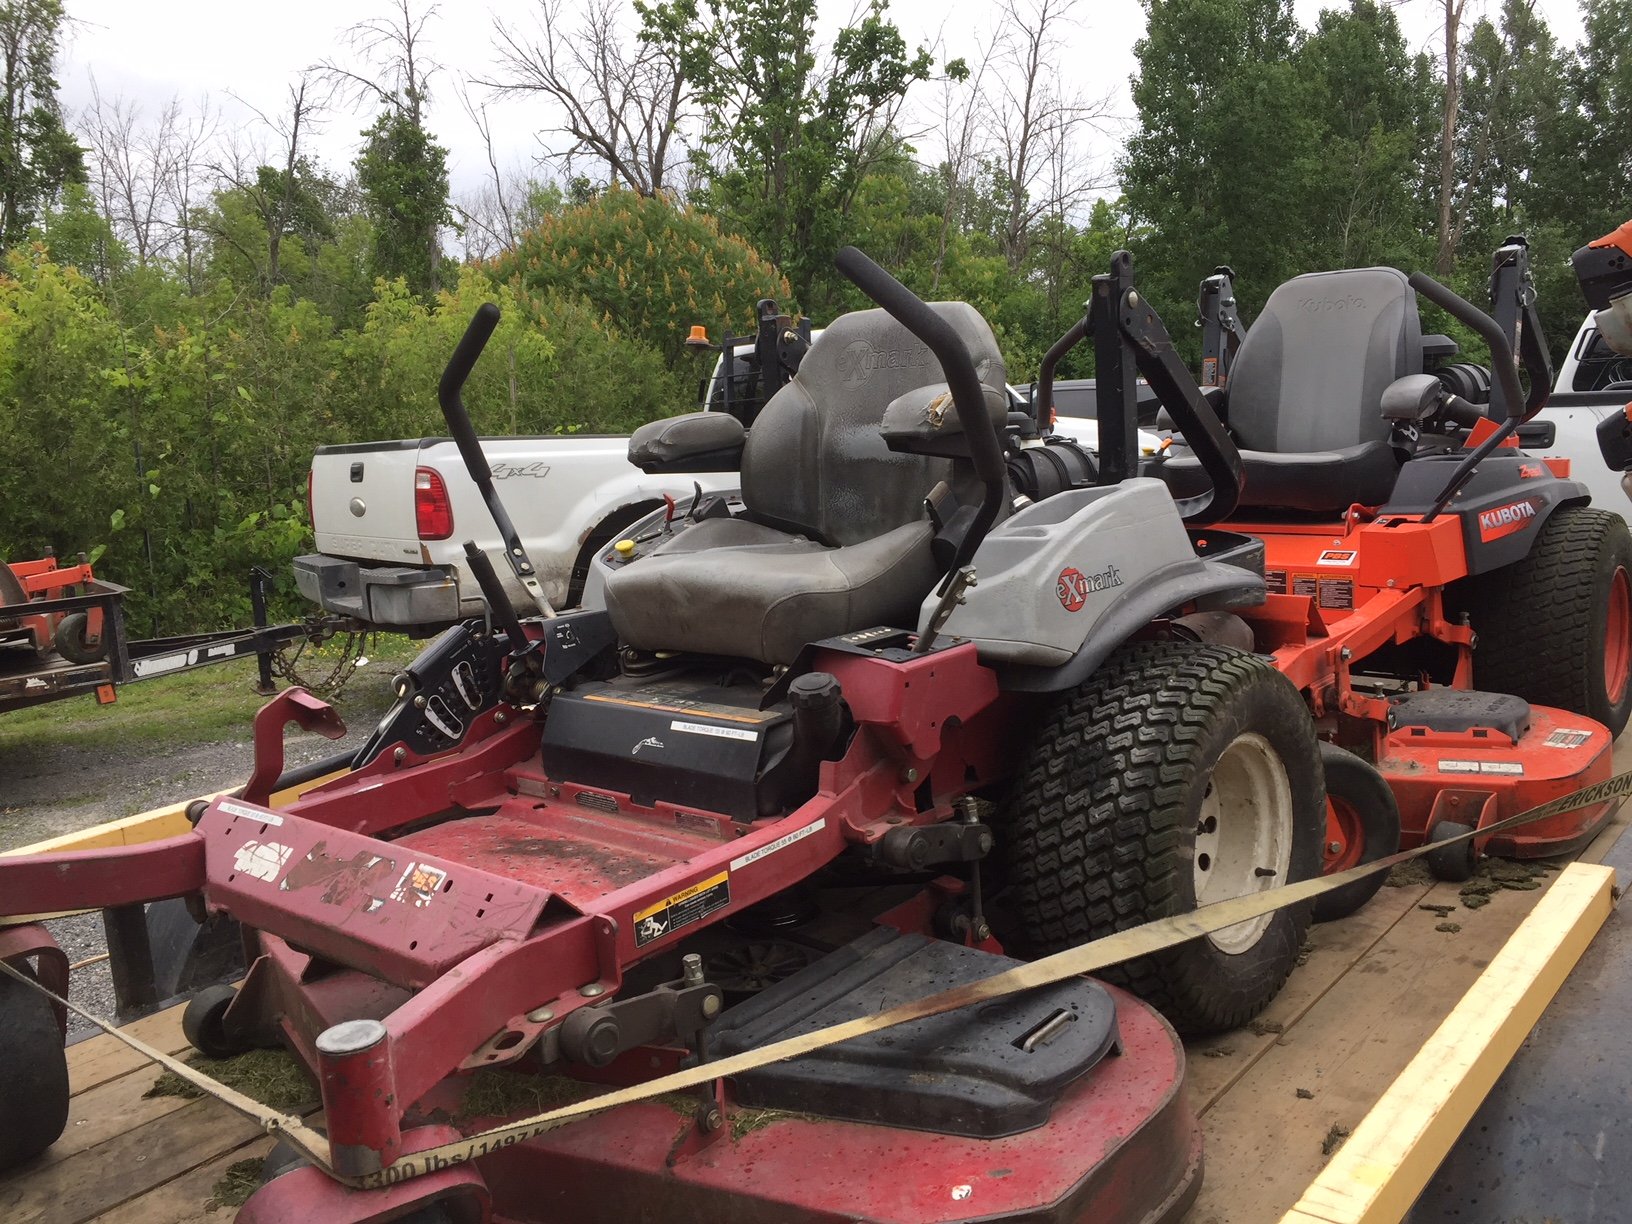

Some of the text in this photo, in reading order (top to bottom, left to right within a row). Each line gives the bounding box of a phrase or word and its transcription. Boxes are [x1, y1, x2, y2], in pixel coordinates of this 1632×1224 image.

[1298, 294, 1366, 312] Kubota
[490, 461, 550, 480] 4x4
[1480, 502, 1536, 529] KUBOTA
[1056, 564, 1124, 608] eXmark
[1558, 773, 1632, 811] ERICKSON
[744, 849, 761, 863] BLADE
[761, 842, 781, 856] TORQUE
[672, 886, 699, 902] WARNING
